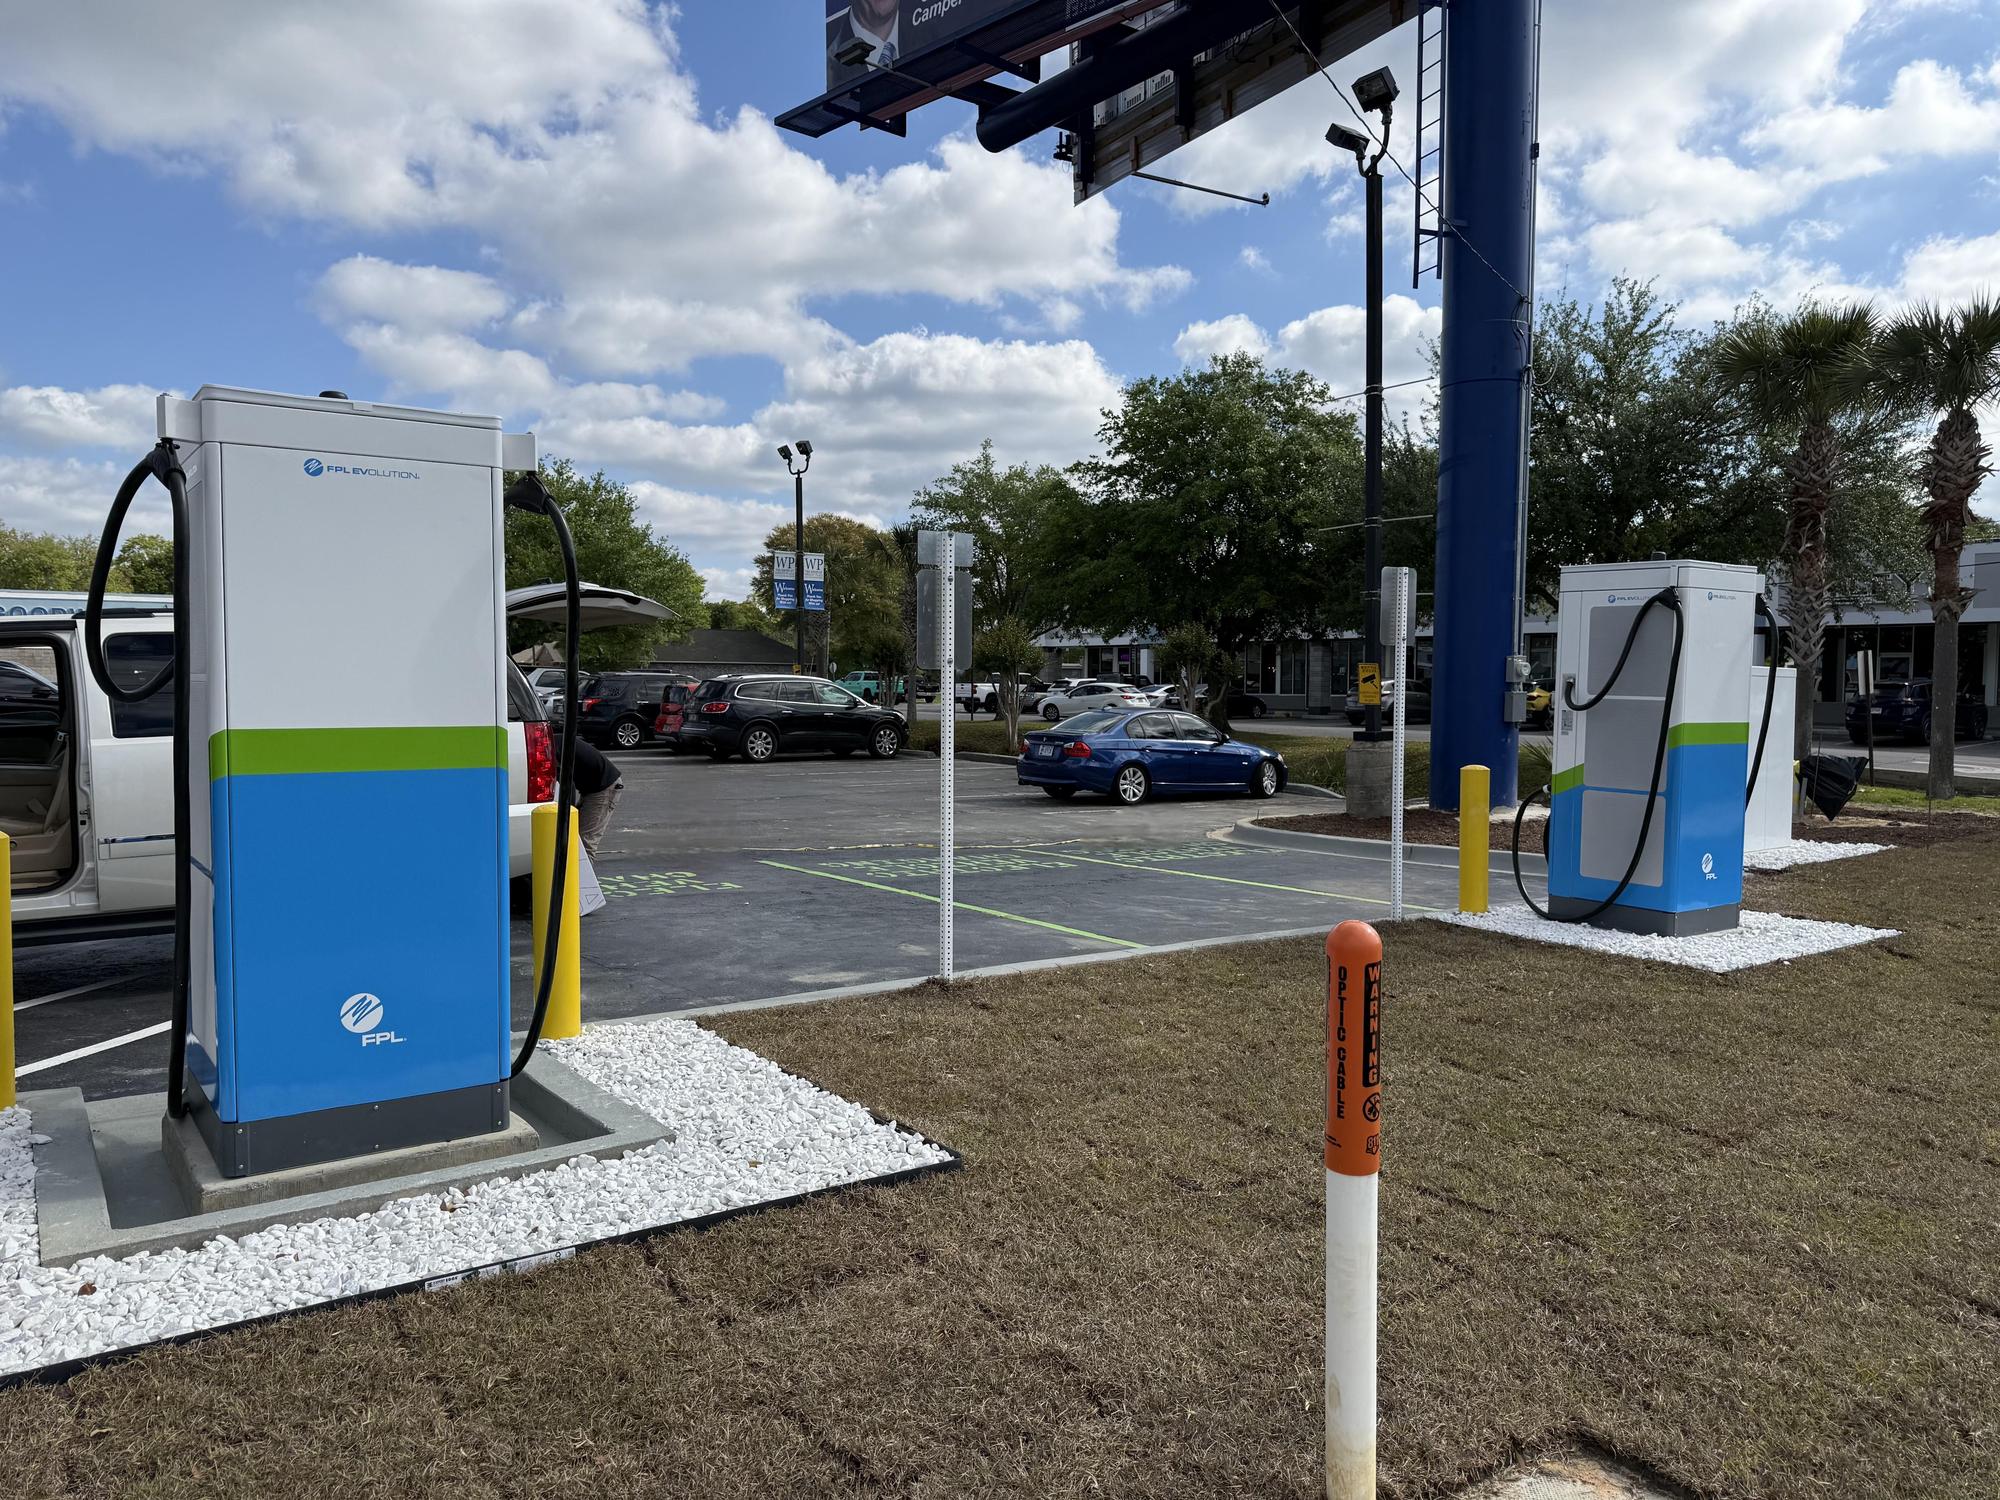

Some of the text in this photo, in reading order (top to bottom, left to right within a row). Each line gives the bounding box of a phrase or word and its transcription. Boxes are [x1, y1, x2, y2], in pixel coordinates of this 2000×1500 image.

[327, 465, 350, 474] FPL
[776, 556, 795, 569] WP
[804, 557, 824, 571] WP
[1368, 966, 1380, 1084] WARNING
[361, 1031, 404, 1047] FPL
[1336, 966, 1348, 1119] OPTIC CABLE
